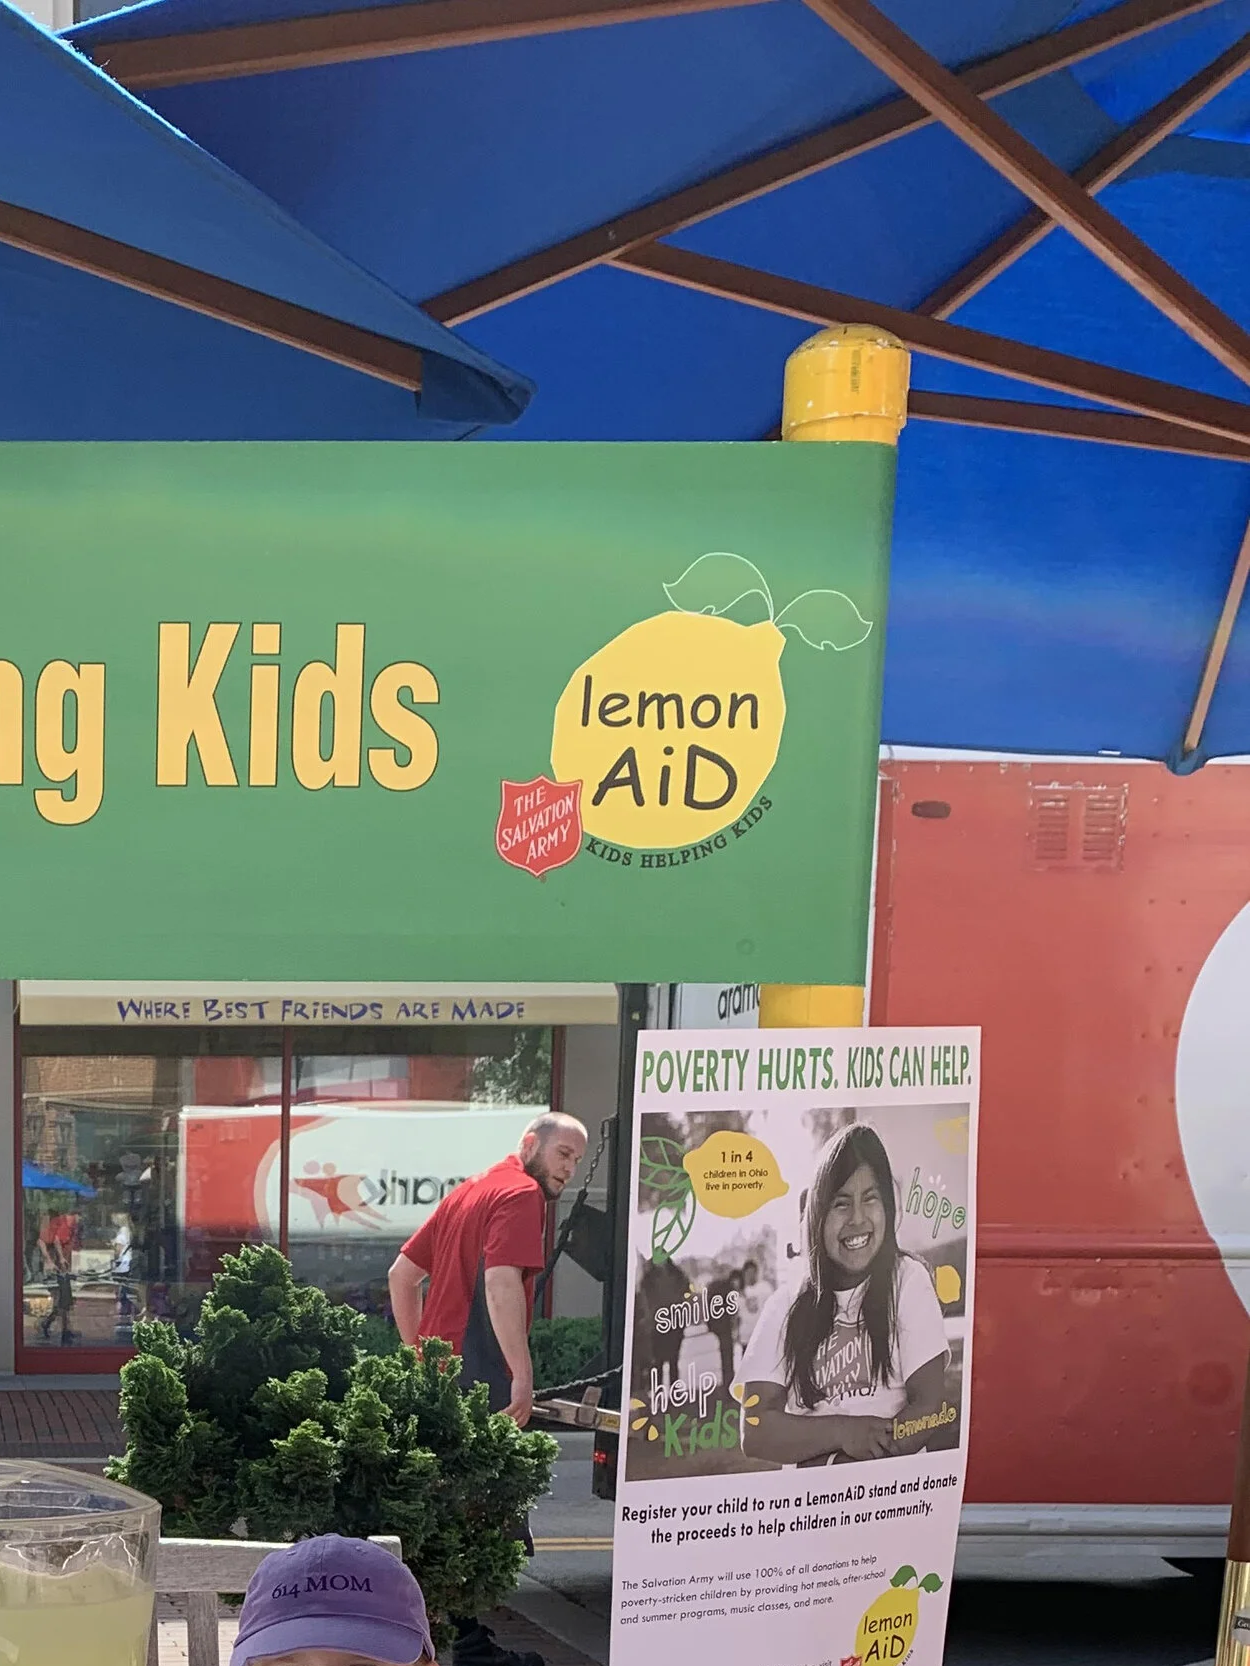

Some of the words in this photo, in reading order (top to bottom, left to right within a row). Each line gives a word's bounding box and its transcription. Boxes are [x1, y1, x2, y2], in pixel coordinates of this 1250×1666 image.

[155, 621, 441, 792] Kids
[581, 675, 758, 730] lemon
[591, 744, 738, 811] AiD
[500, 791, 574, 852] SALVATION
[514, 786, 547, 817] THE
[526, 820, 572, 864] ARMY
[586, 838, 633, 866] KIDS
[640, 834, 727, 869] HELPING
[732, 795, 773, 839] KIDS
[117, 998, 191, 1022] WHERE
[204, 998, 270, 1022] BEST
[396, 1001, 440, 1020] ARE
[451, 999, 525, 1022] MADE
[641, 1049, 750, 1093] POVERTY
[758, 1047, 838, 1090] HURTS.
[846, 1046, 883, 1088] KIDS
[889, 1045, 925, 1087] CAN
[931, 1045, 971, 1085] HELP.
[703, 1170, 737, 1179] children
[739, 1169, 747, 1178] in
[748, 1169, 769, 1178] Ohio
[721, 1151, 726, 1163] 1
[731, 1151, 742, 1163] in
[745, 1150, 753, 1162] 4
[705, 1182, 720, 1191] live
[722, 1182, 730, 1190] in
[906, 1166, 966, 1239] hope
[654, 1287, 740, 1334] smiles
[650, 1362, 717, 1418] help
[663, 1400, 740, 1458] Kids
[893, 1402, 957, 1441] lemonade
[621, 1504, 677, 1523] Register
[682, 1505, 712, 1521] your
[716, 1497, 748, 1514] child
[753, 1498, 765, 1511] to
[769, 1497, 790, 1510] run
[794, 1497, 802, 1507] a
[806, 1485, 865, 1507] LemonAiD
[868, 1480, 897, 1499] stand
[900, 1477, 920, 1493] and
[922, 1473, 958, 1490] donate
[651, 1528, 672, 1544] the
[677, 1522, 736, 1545] proceeds
[741, 1523, 753, 1536] to
[758, 1518, 786, 1537] help
[789, 1514, 837, 1533] children
[840, 1511, 850, 1526] in
[854, 1511, 872, 1524] our
[875, 1499, 933, 1521] community.
[271, 1583, 300, 1599] 614
[304, 1574, 373, 1593] MOM
[621, 1593, 697, 1609] poverty-stricken
[700, 1587, 737, 1601] children
[740, 1586, 751, 1598] by
[755, 1582, 798, 1596] providing
[801, 1581, 815, 1591] hot
[816, 1577, 841, 1588] meals,
[842, 1568, 886, 1585] after-school
[622, 1580, 639, 1591] The
[641, 1577, 686, 1589] Salvation
[688, 1574, 714, 1585] Army
[717, 1571, 733, 1582] will
[735, 1572, 751, 1580] use
[755, 1566, 783, 1579] 100%
[786, 1566, 796, 1576] of
[799, 1564, 810, 1575] all
[812, 1560, 849, 1573] donations
[851, 1558, 859, 1567] to
[861, 1554, 877, 1566] help
[620, 1616, 638, 1625] and
[642, 1612, 677, 1622] summer
[680, 1607, 727, 1621] programs,
[730, 1604, 755, 1614] music
[757, 1601, 792, 1612] classes,
[794, 1598, 810, 1608] and
[813, 1595, 834, 1605] more.
[863, 1613, 912, 1634] lemon
[865, 1634, 905, 1663] AiD
